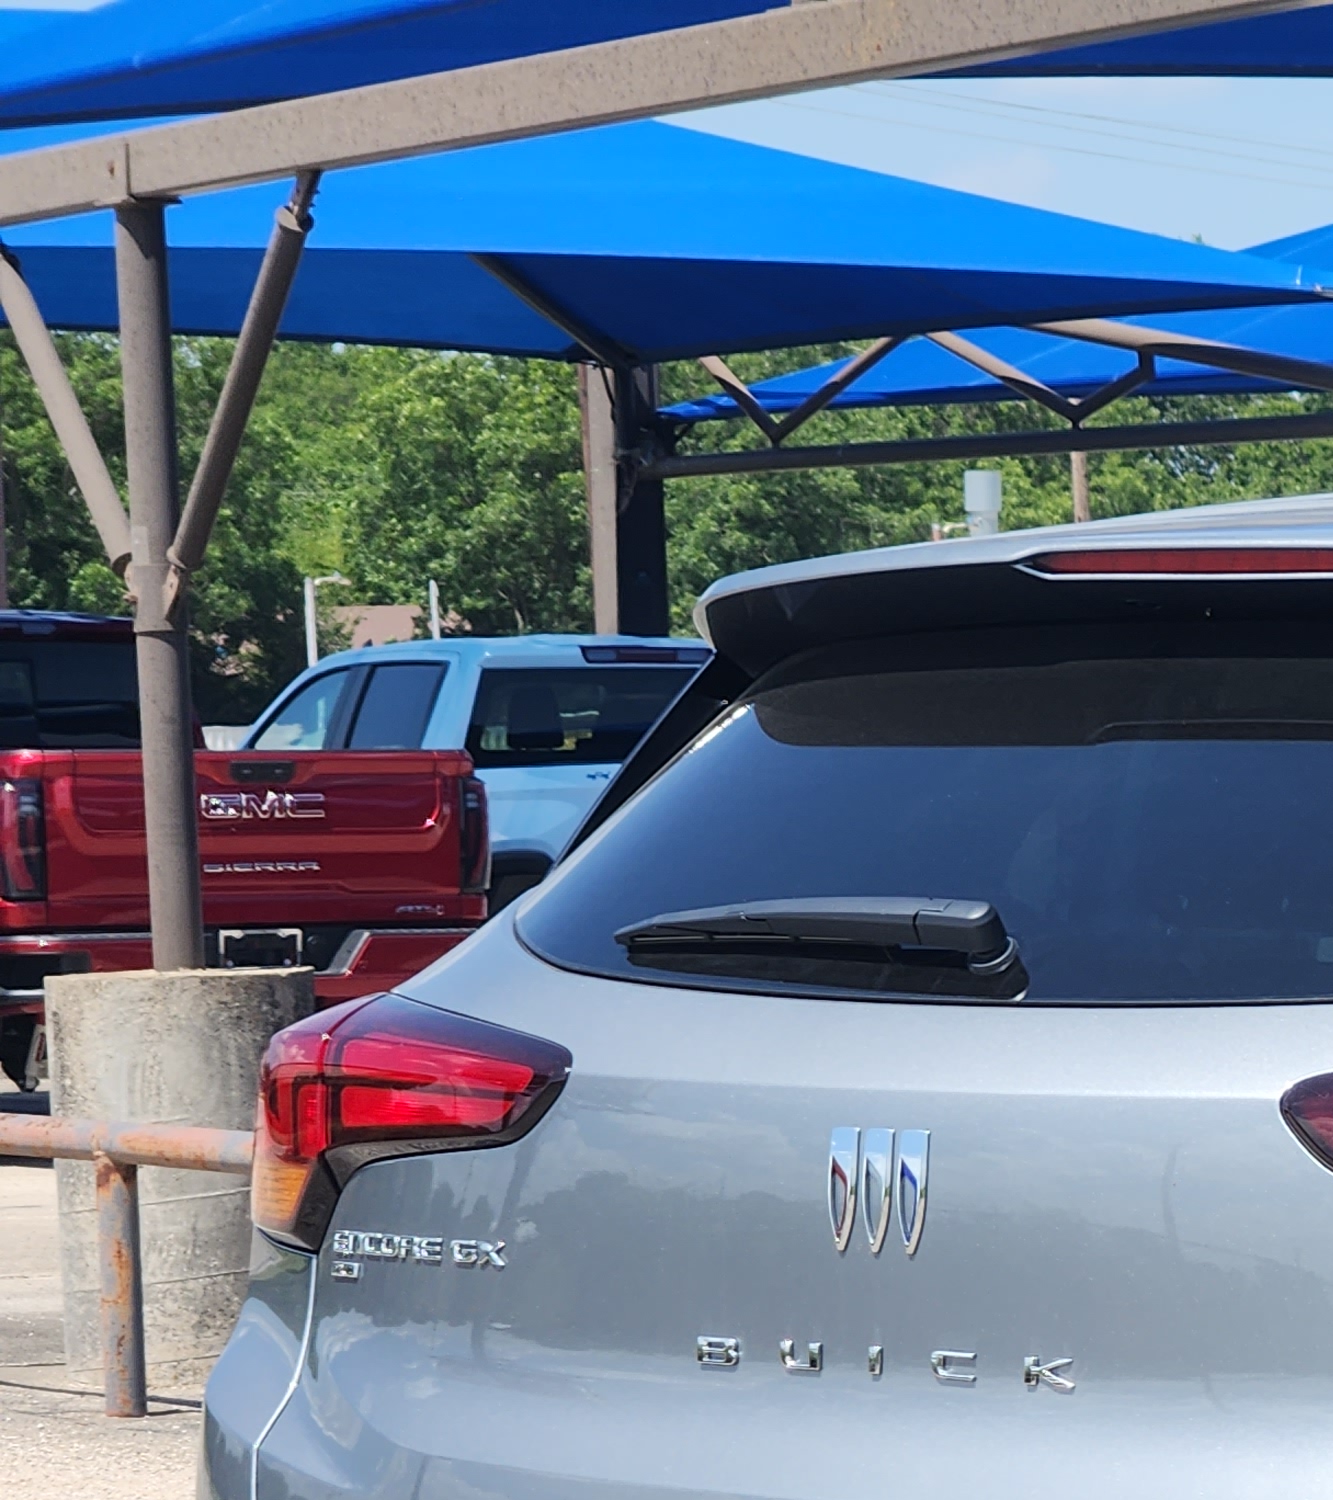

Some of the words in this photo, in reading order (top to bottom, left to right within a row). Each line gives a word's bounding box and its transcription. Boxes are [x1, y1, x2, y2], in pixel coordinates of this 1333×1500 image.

[200, 790, 326, 819] GMC
[203, 861, 321, 874] SIERRA
[333, 1230, 443, 1261] ENCORE
[451, 1239, 507, 1267] GX
[697, 1335, 1076, 1390] BUICK
